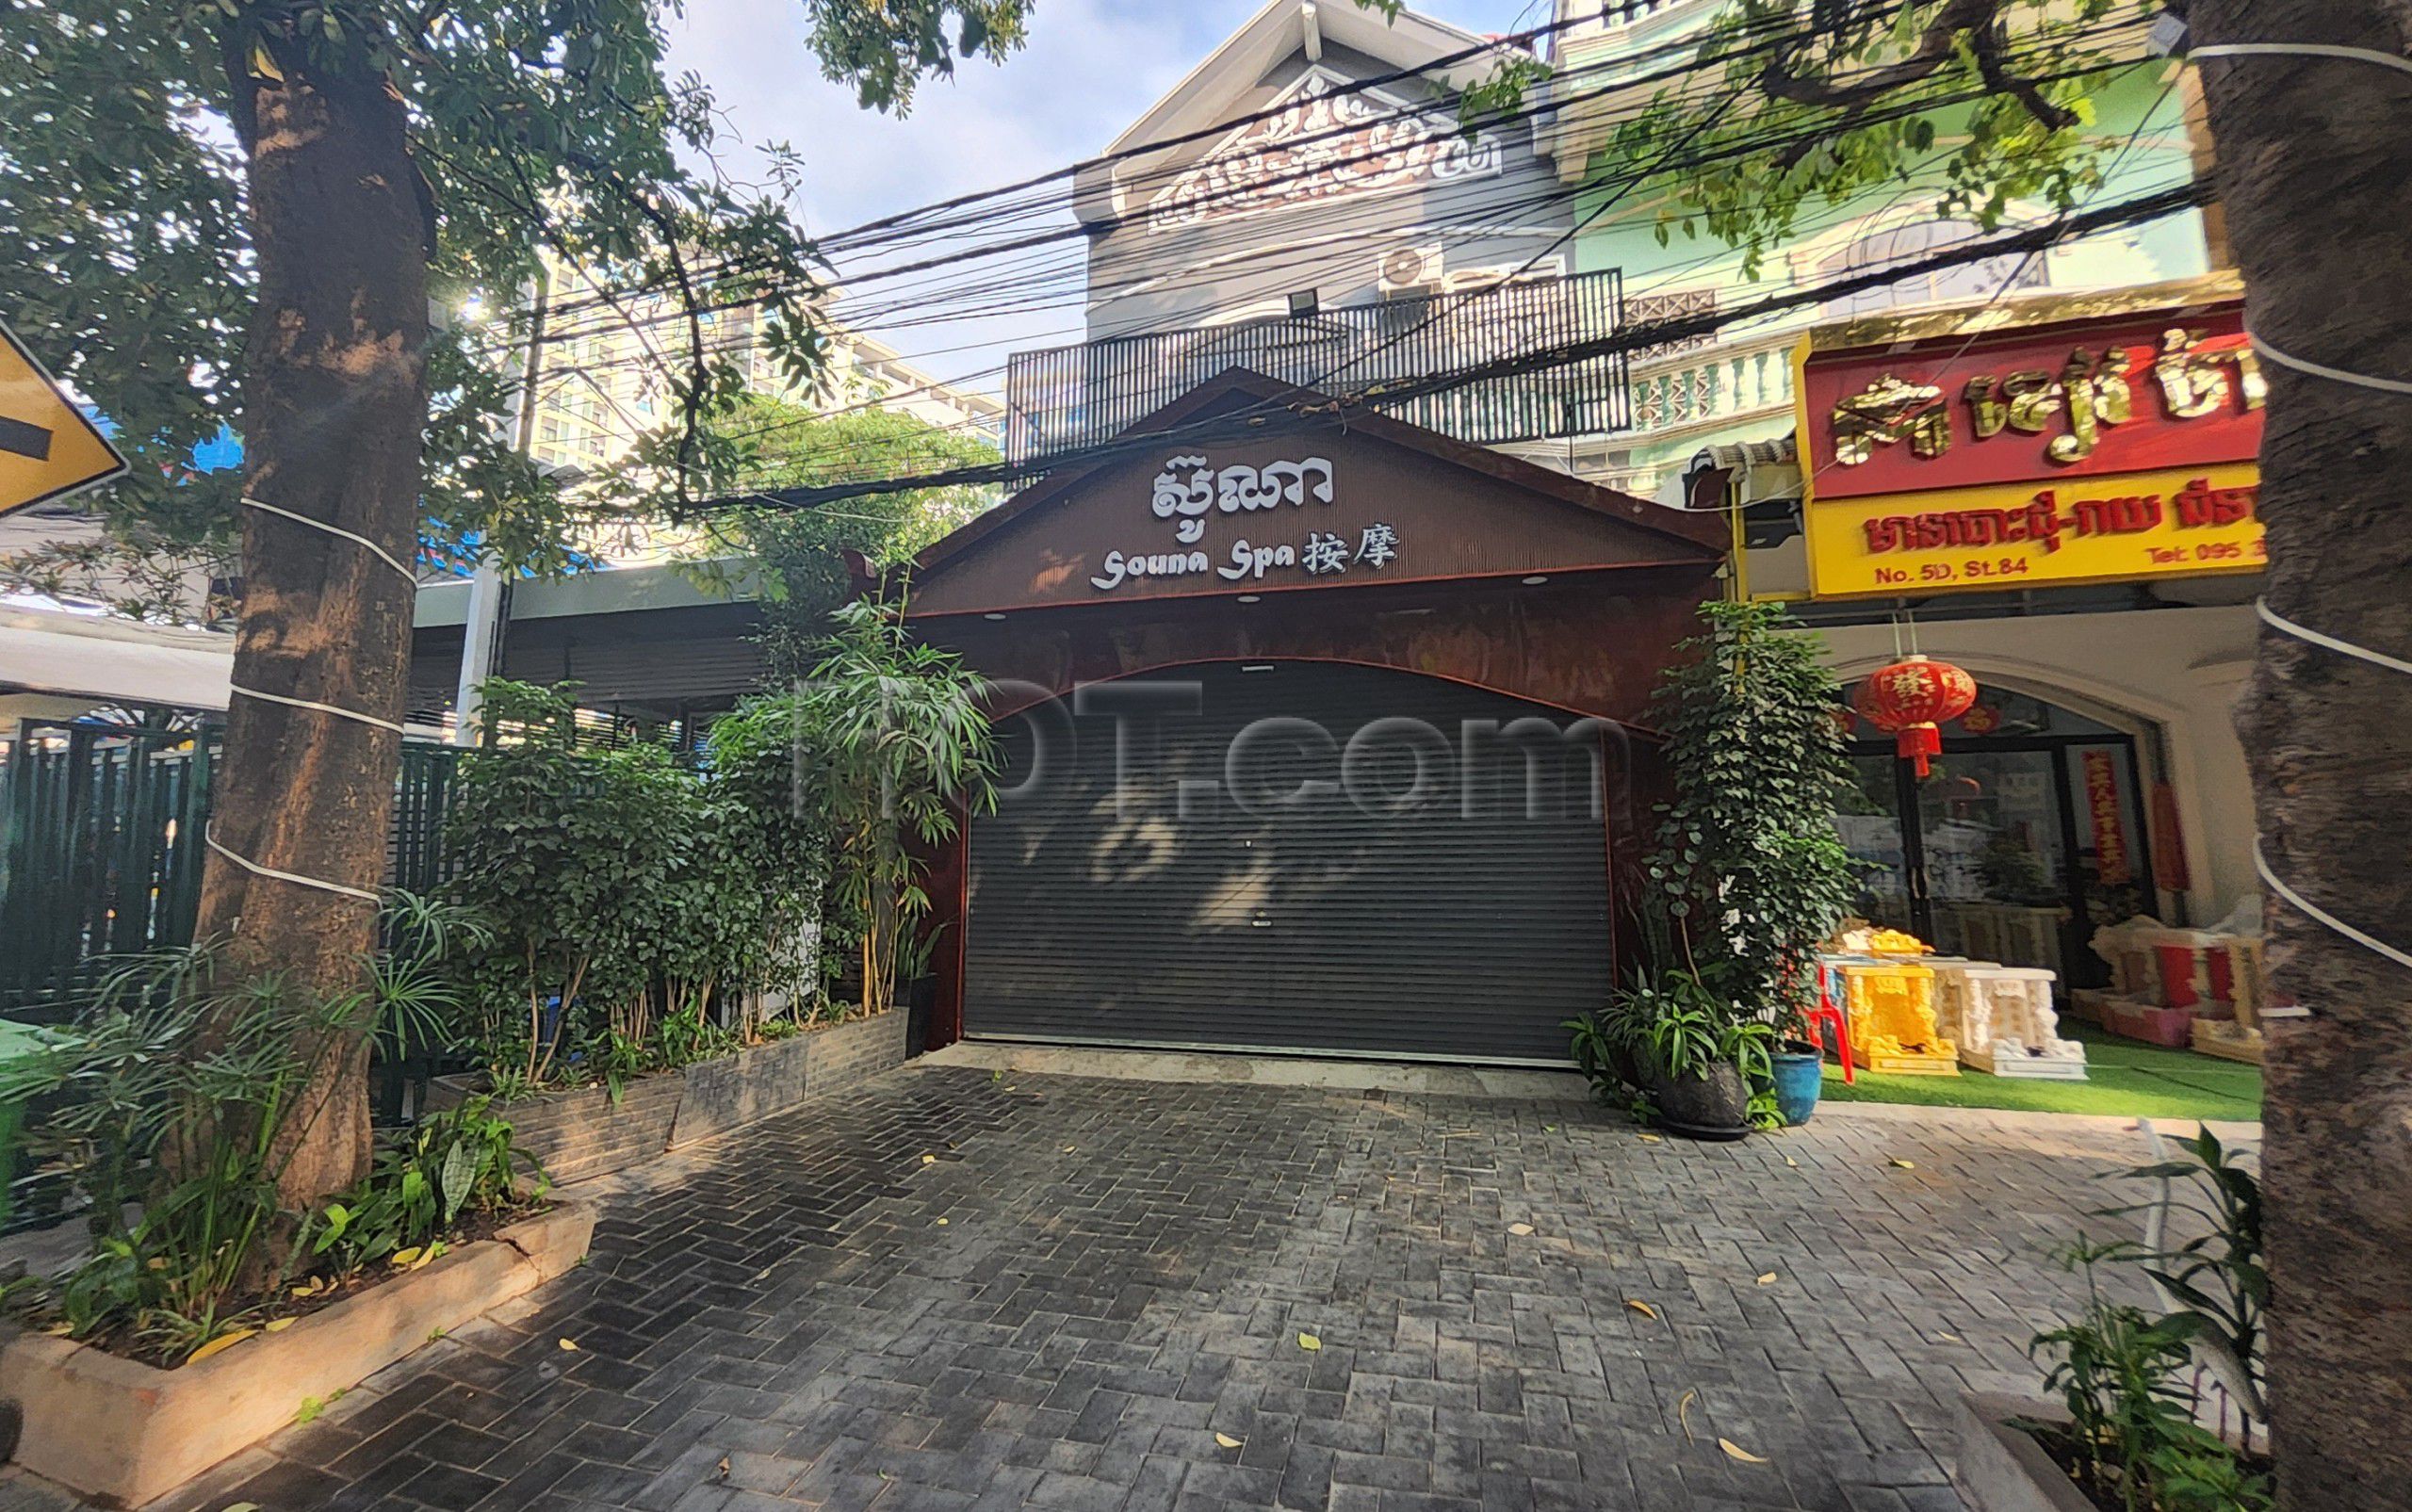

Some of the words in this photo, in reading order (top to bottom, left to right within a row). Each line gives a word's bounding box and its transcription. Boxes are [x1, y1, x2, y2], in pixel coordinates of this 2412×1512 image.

[1090, 549, 1209, 591] Souna
[1216, 538, 1296, 580] Spa
[1300, 520, 1401, 576] 按摩
[1875, 567, 1915, 584] No.
